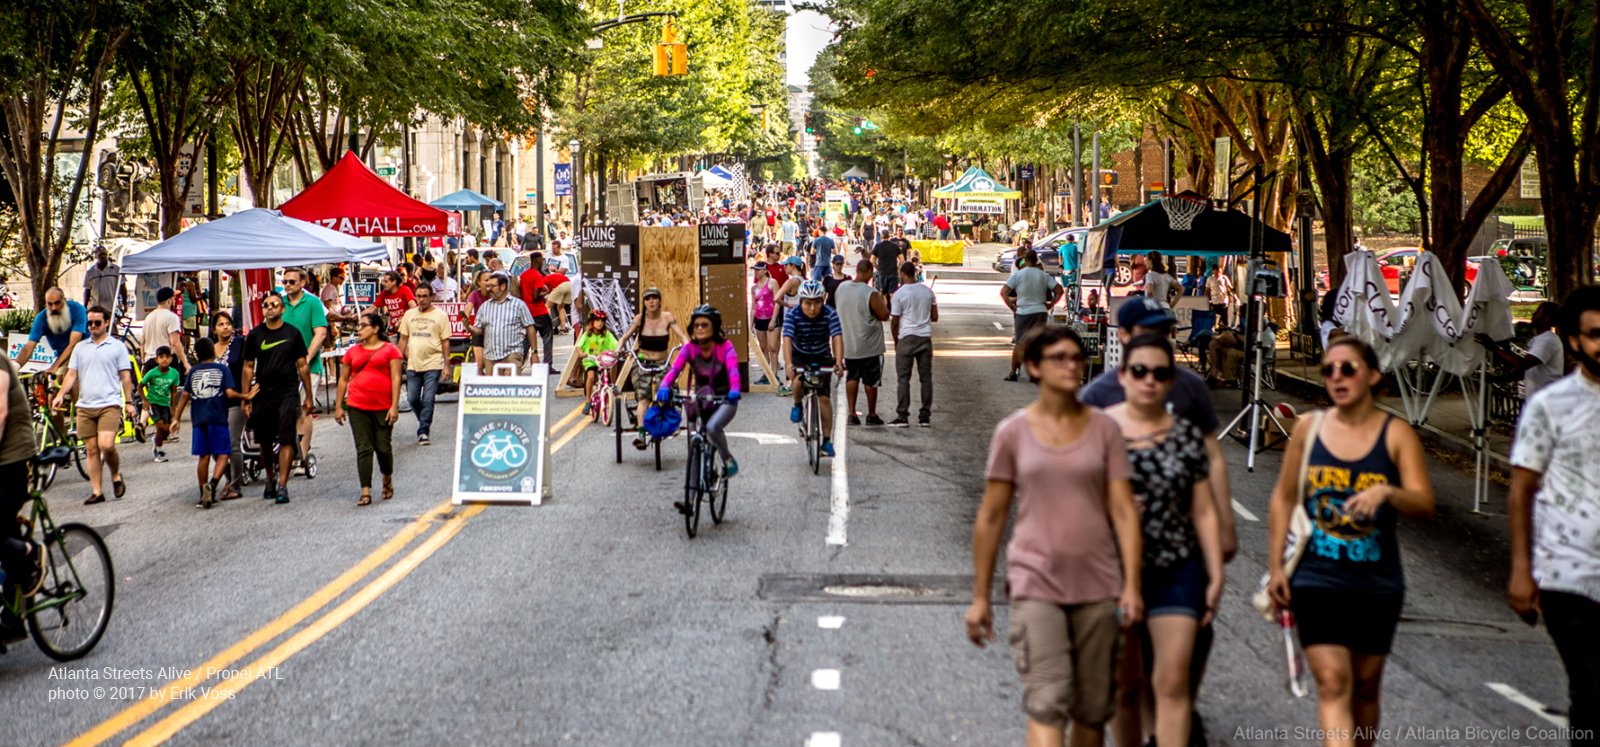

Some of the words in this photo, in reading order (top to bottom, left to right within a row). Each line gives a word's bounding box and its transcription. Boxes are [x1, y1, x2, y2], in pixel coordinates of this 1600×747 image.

[960, 204, 1002, 212] INFORMATION
[582, 226, 615, 241] LIVING
[700, 225, 729, 239] LIVING
[582, 240, 615, 248] INFOGRAPHIC
[465, 386, 516, 396] CANDIDATE
[517, 386, 541, 397] ROW
[473, 422, 495, 440] BIKE
[510, 424, 530, 445] VOTE
